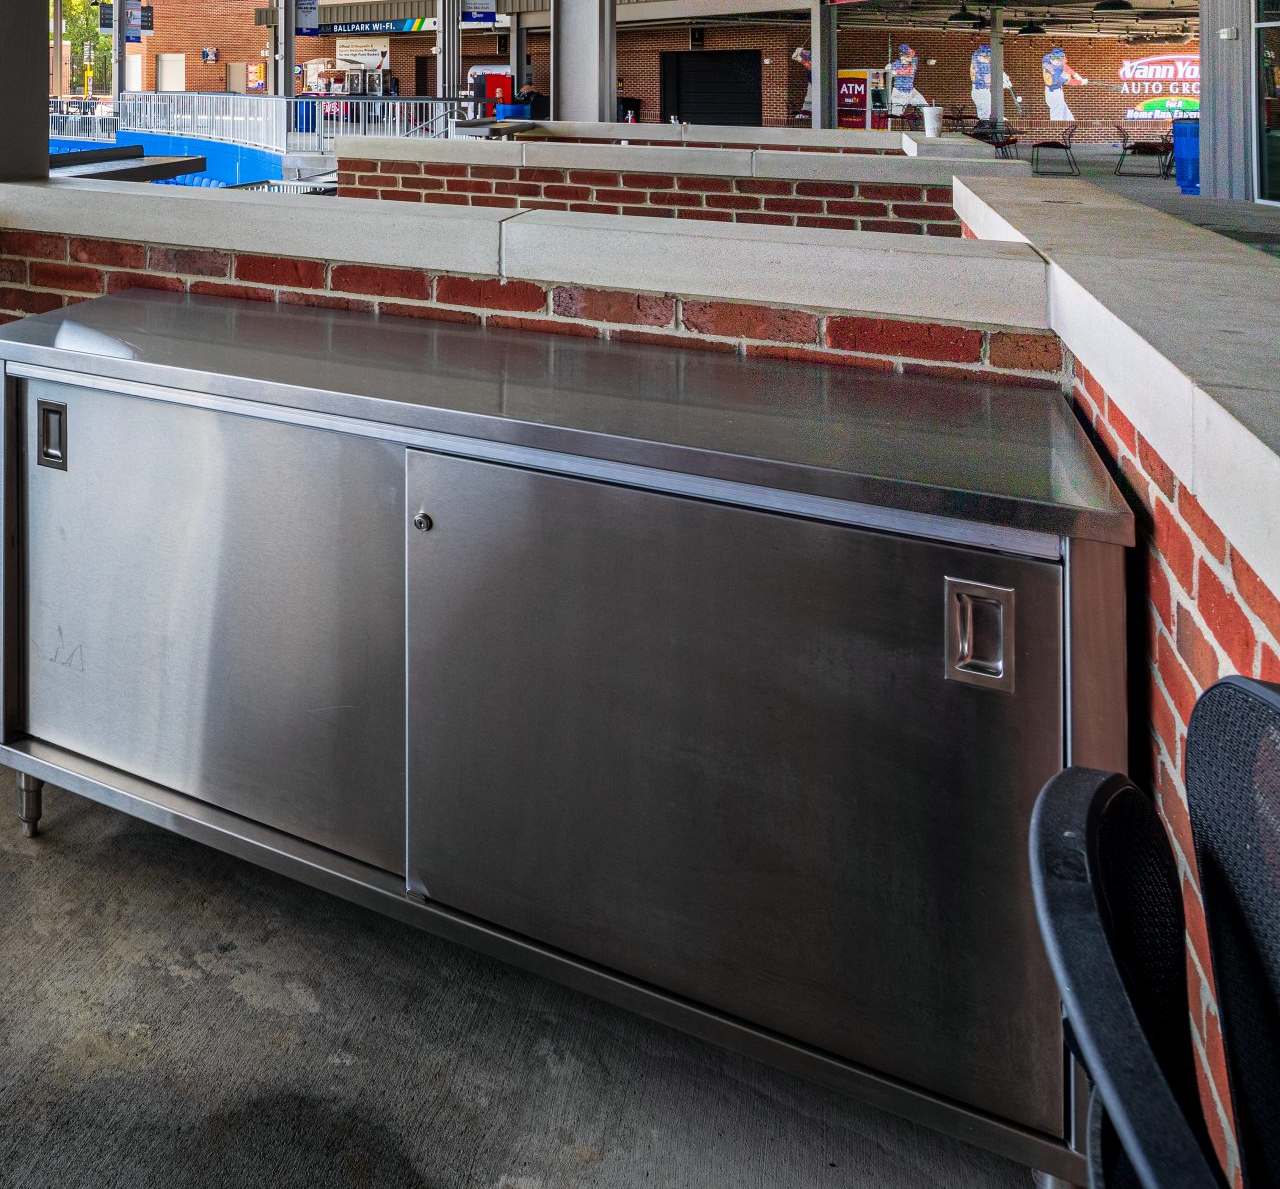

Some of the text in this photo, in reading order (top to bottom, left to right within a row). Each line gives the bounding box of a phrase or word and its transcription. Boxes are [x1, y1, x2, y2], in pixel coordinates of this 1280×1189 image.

[333, 23, 370, 33] BALLPARK
[1120, 60, 1175, 80] Vann
[840, 83, 865, 95] ATM
[1120, 81, 1163, 94] AUTO
[1166, 100, 1177, 108] For
[1126, 109, 1154, 119] Home
[1154, 109, 1171, 119] Run
